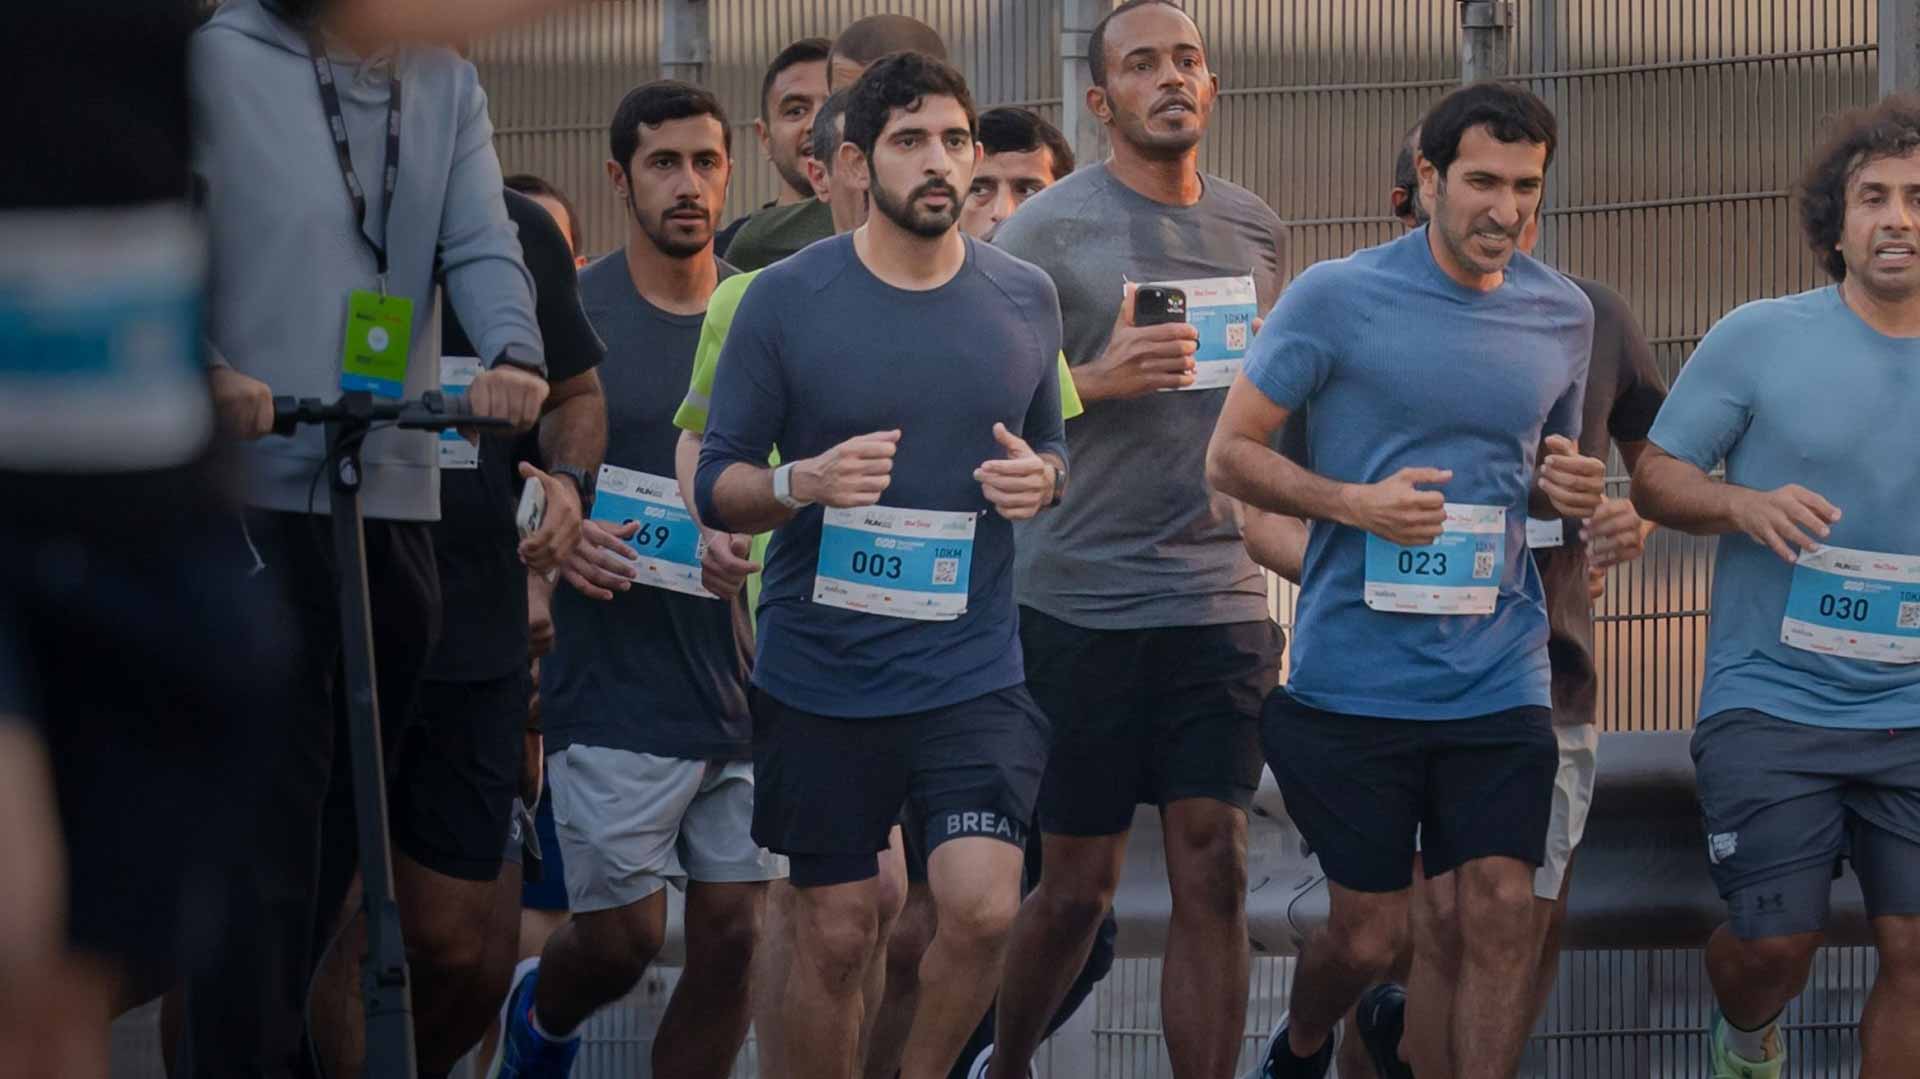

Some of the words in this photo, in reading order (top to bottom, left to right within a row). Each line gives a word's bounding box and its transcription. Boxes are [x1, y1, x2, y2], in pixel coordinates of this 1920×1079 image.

[852, 550, 902, 579] 003
[935, 547, 962, 558] 10KM
[1398, 551, 1447, 576] 023
[1819, 594, 1868, 621] 030
